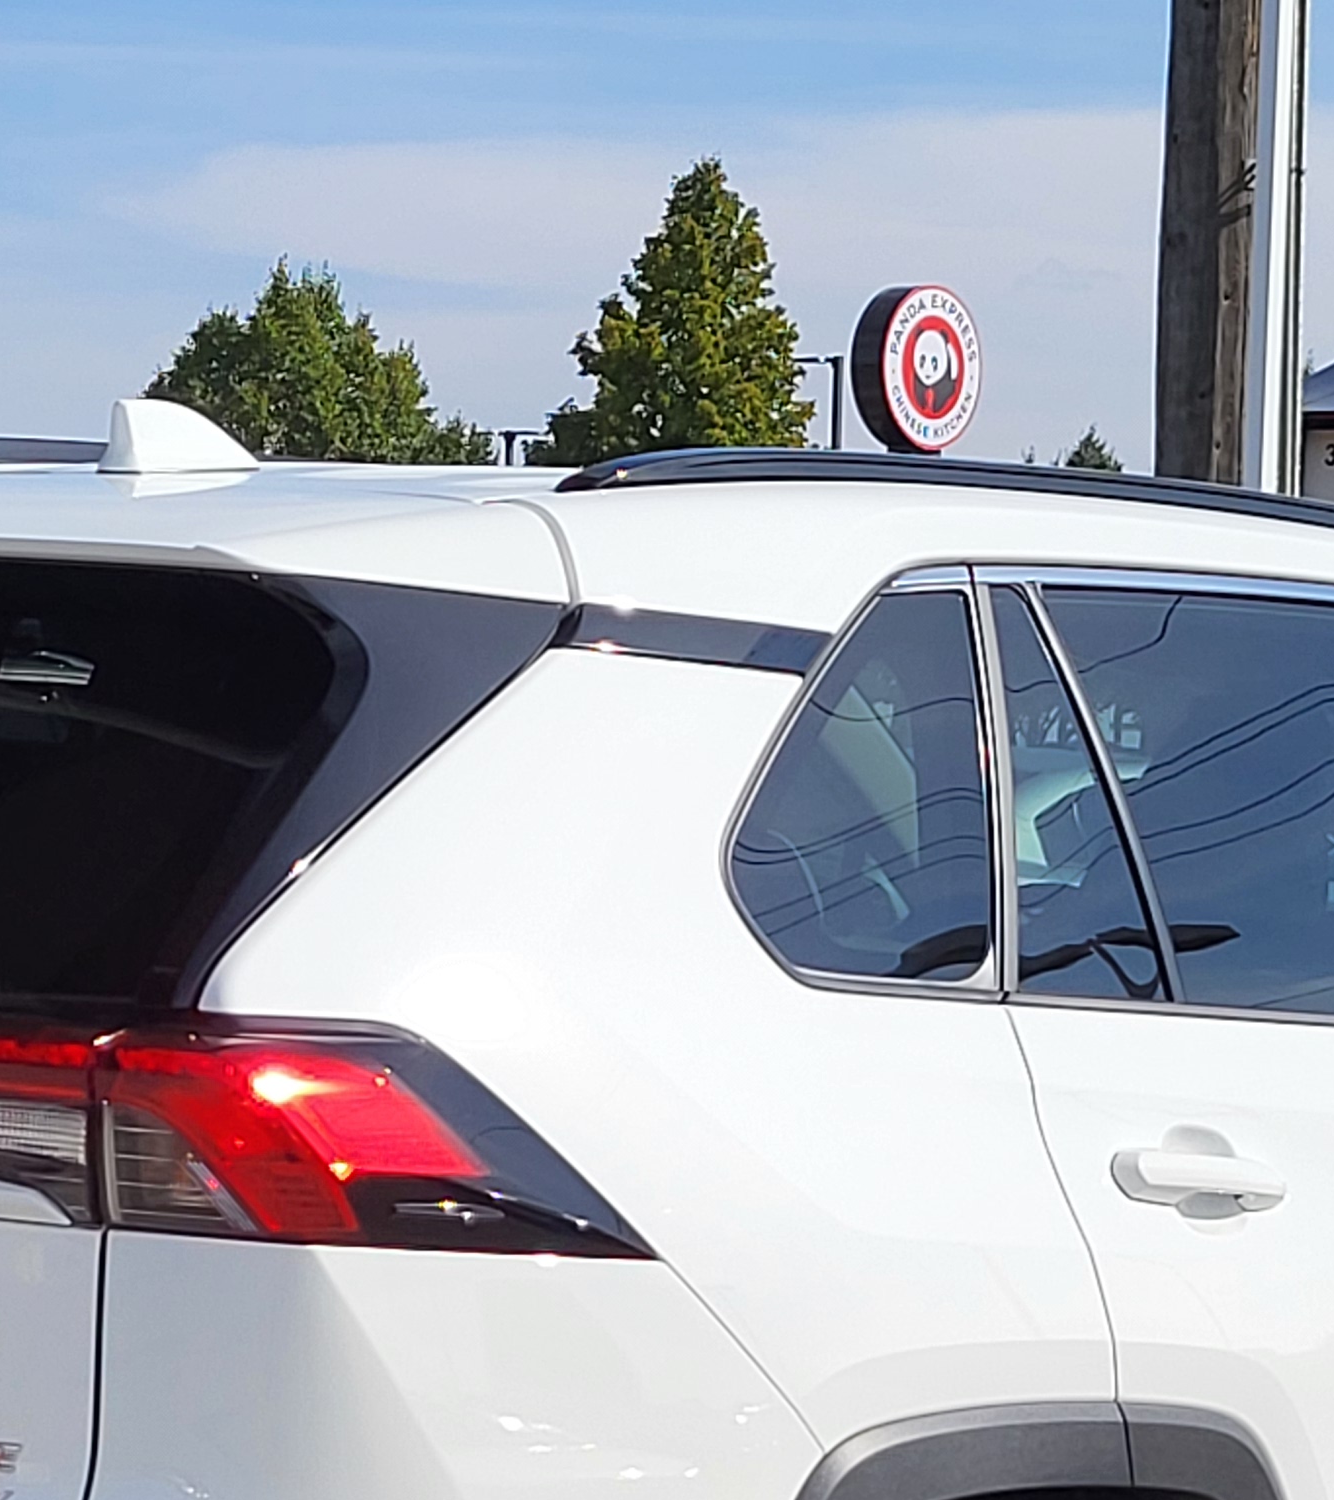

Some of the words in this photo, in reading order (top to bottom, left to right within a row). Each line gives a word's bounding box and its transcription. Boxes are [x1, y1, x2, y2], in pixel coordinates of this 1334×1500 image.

[890, 298, 927, 356] PANDA
[931, 293, 977, 363] EXPRESS
[892, 384, 930, 438] CHINESE
[932, 392, 973, 439] KITCHEN
